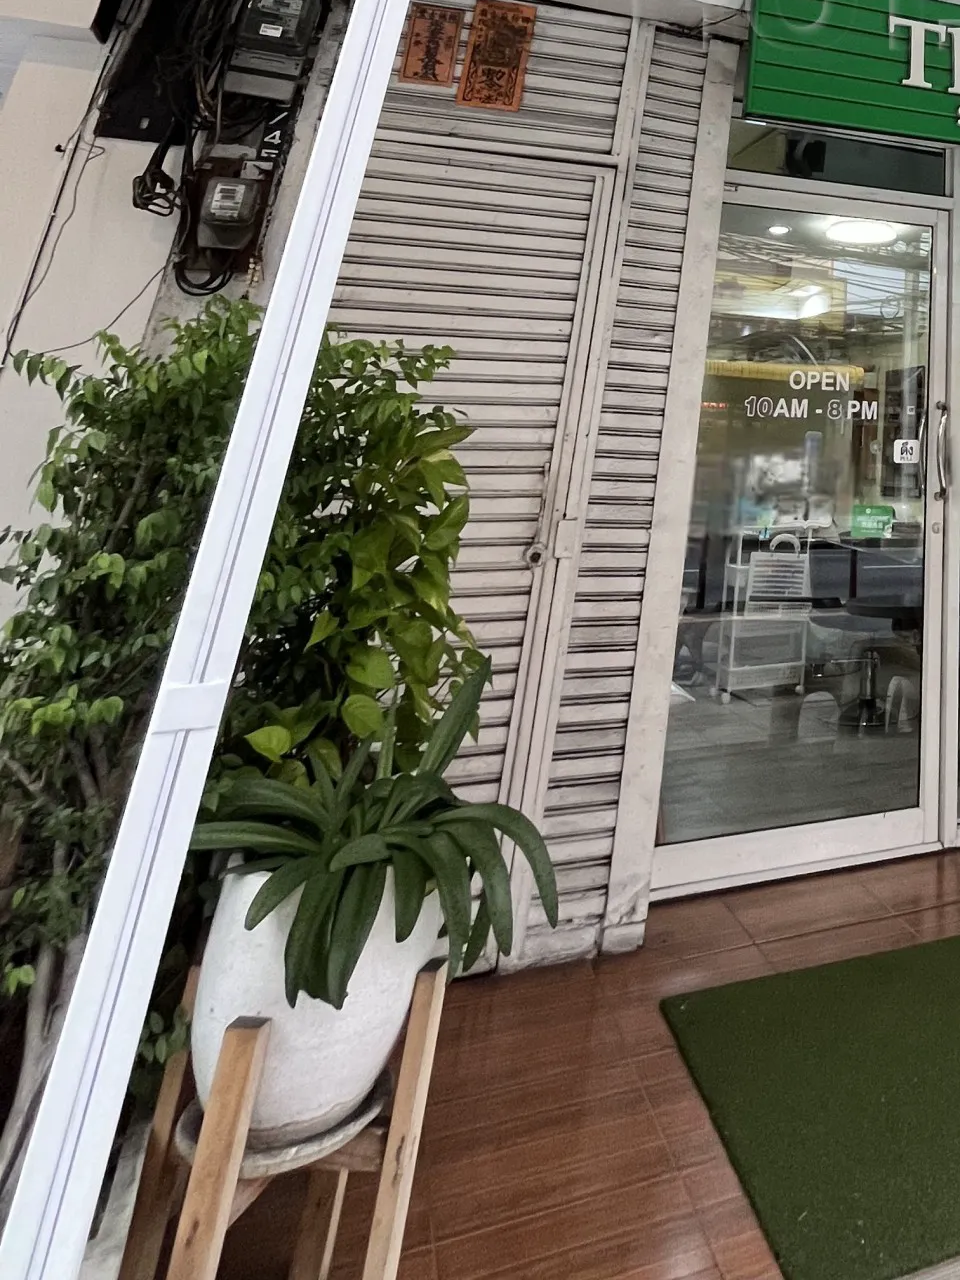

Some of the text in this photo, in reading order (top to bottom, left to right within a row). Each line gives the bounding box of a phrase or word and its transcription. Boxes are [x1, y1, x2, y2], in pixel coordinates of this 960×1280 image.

[789, 370, 850, 391] OPEN
[744, 396, 809, 419] 10AM
[847, 400, 878, 420] PM
